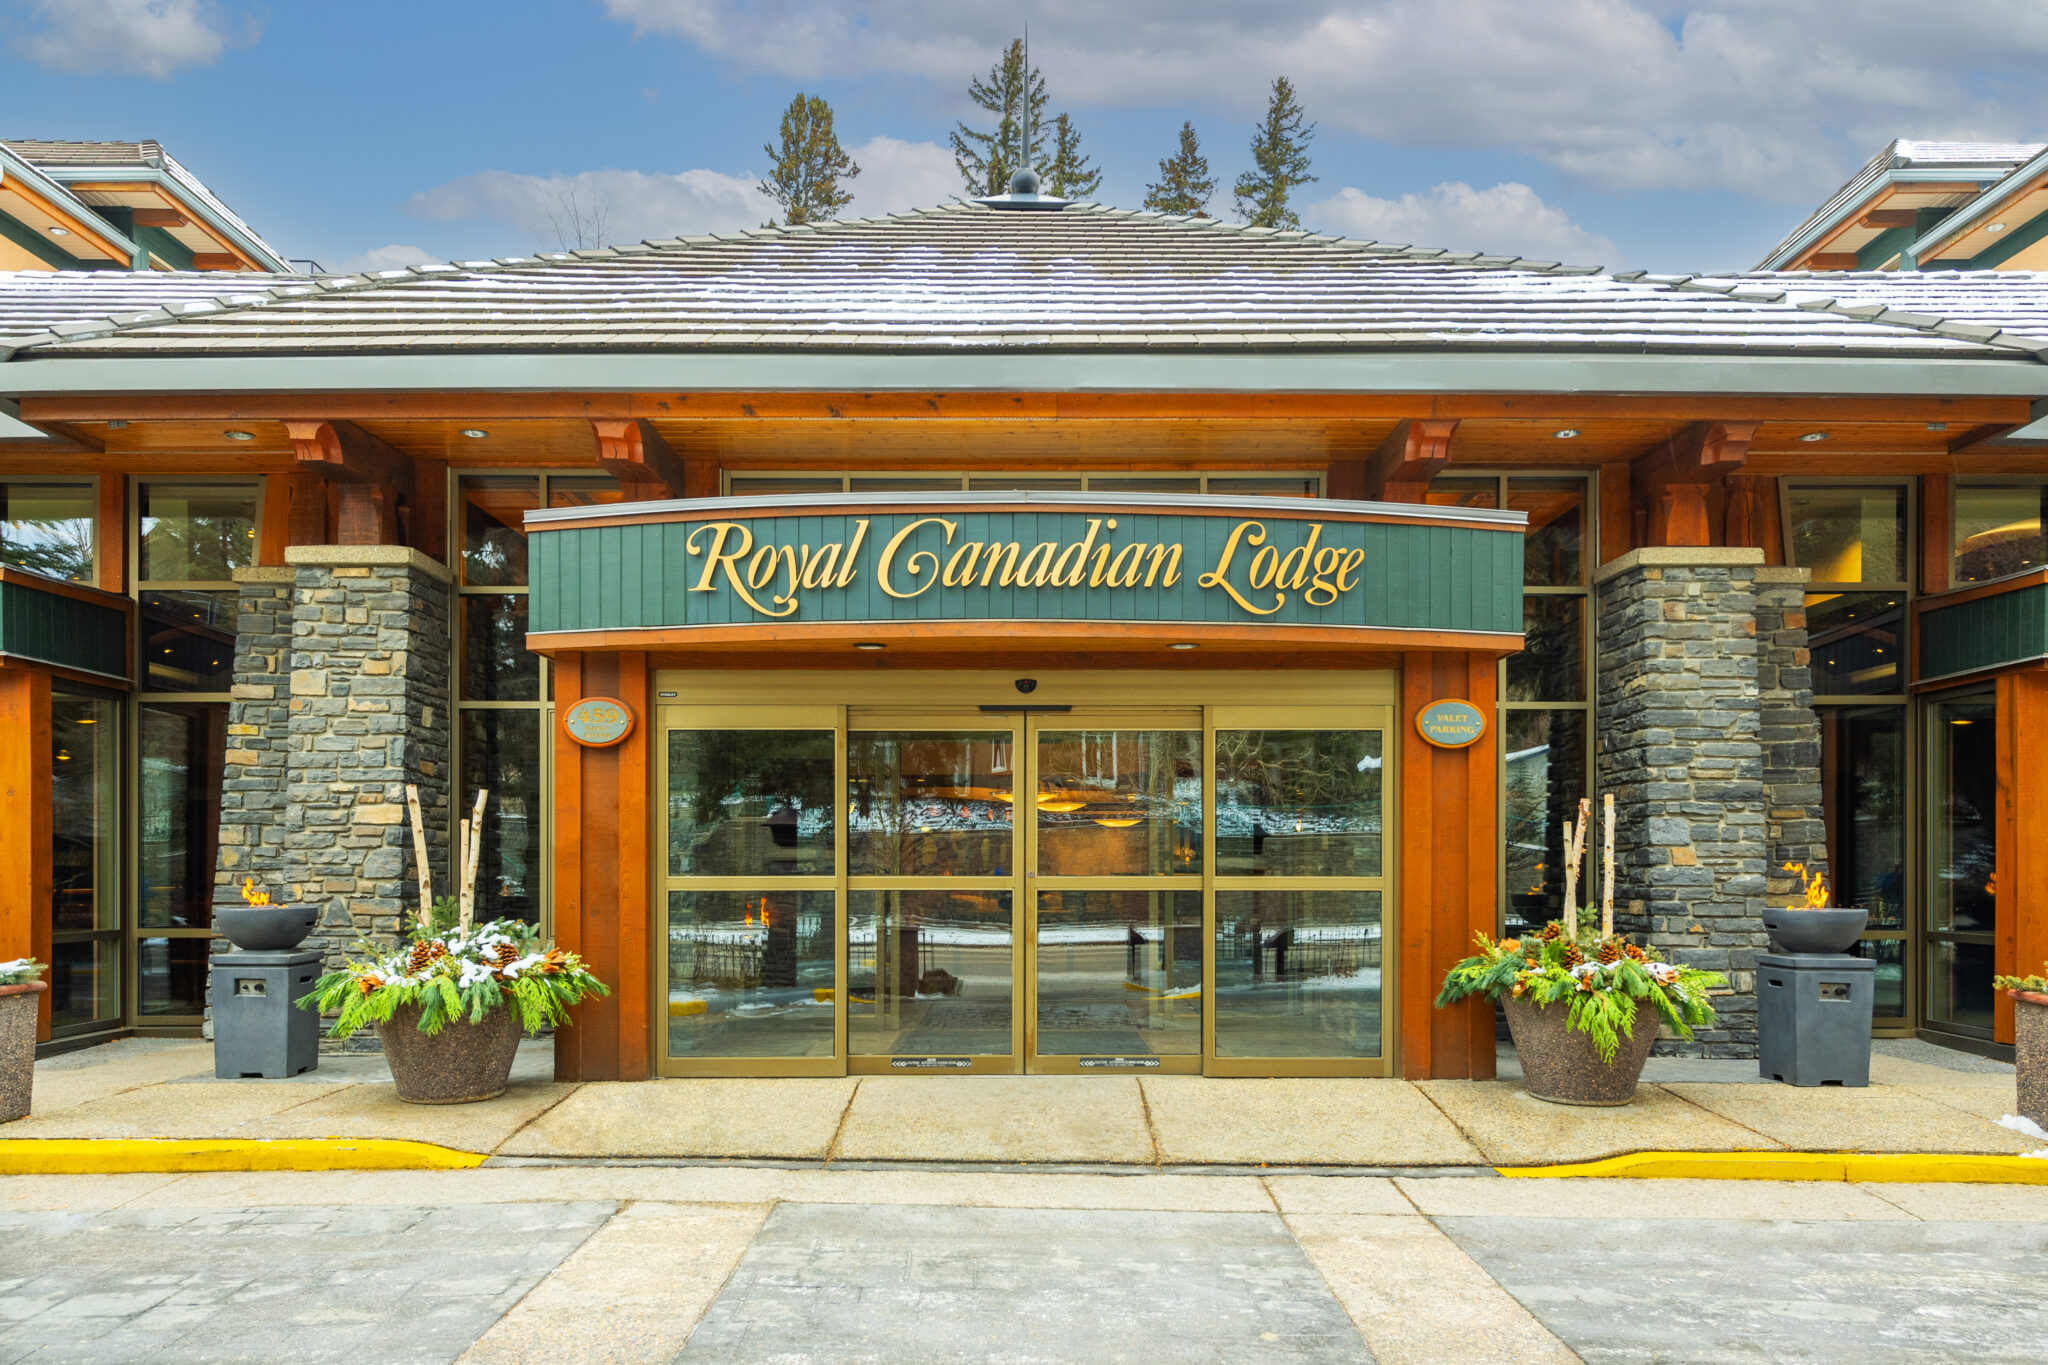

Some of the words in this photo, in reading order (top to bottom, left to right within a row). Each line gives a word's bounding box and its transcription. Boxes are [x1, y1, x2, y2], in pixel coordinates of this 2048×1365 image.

[686, 519, 869, 617] Royal
[877, 517, 1183, 598] Canadian
[1197, 520, 1366, 615] Lodge
[576, 707, 618, 724] 459
[1436, 714, 1468, 722] VALET
[1429, 725, 1475, 734] PARKING
